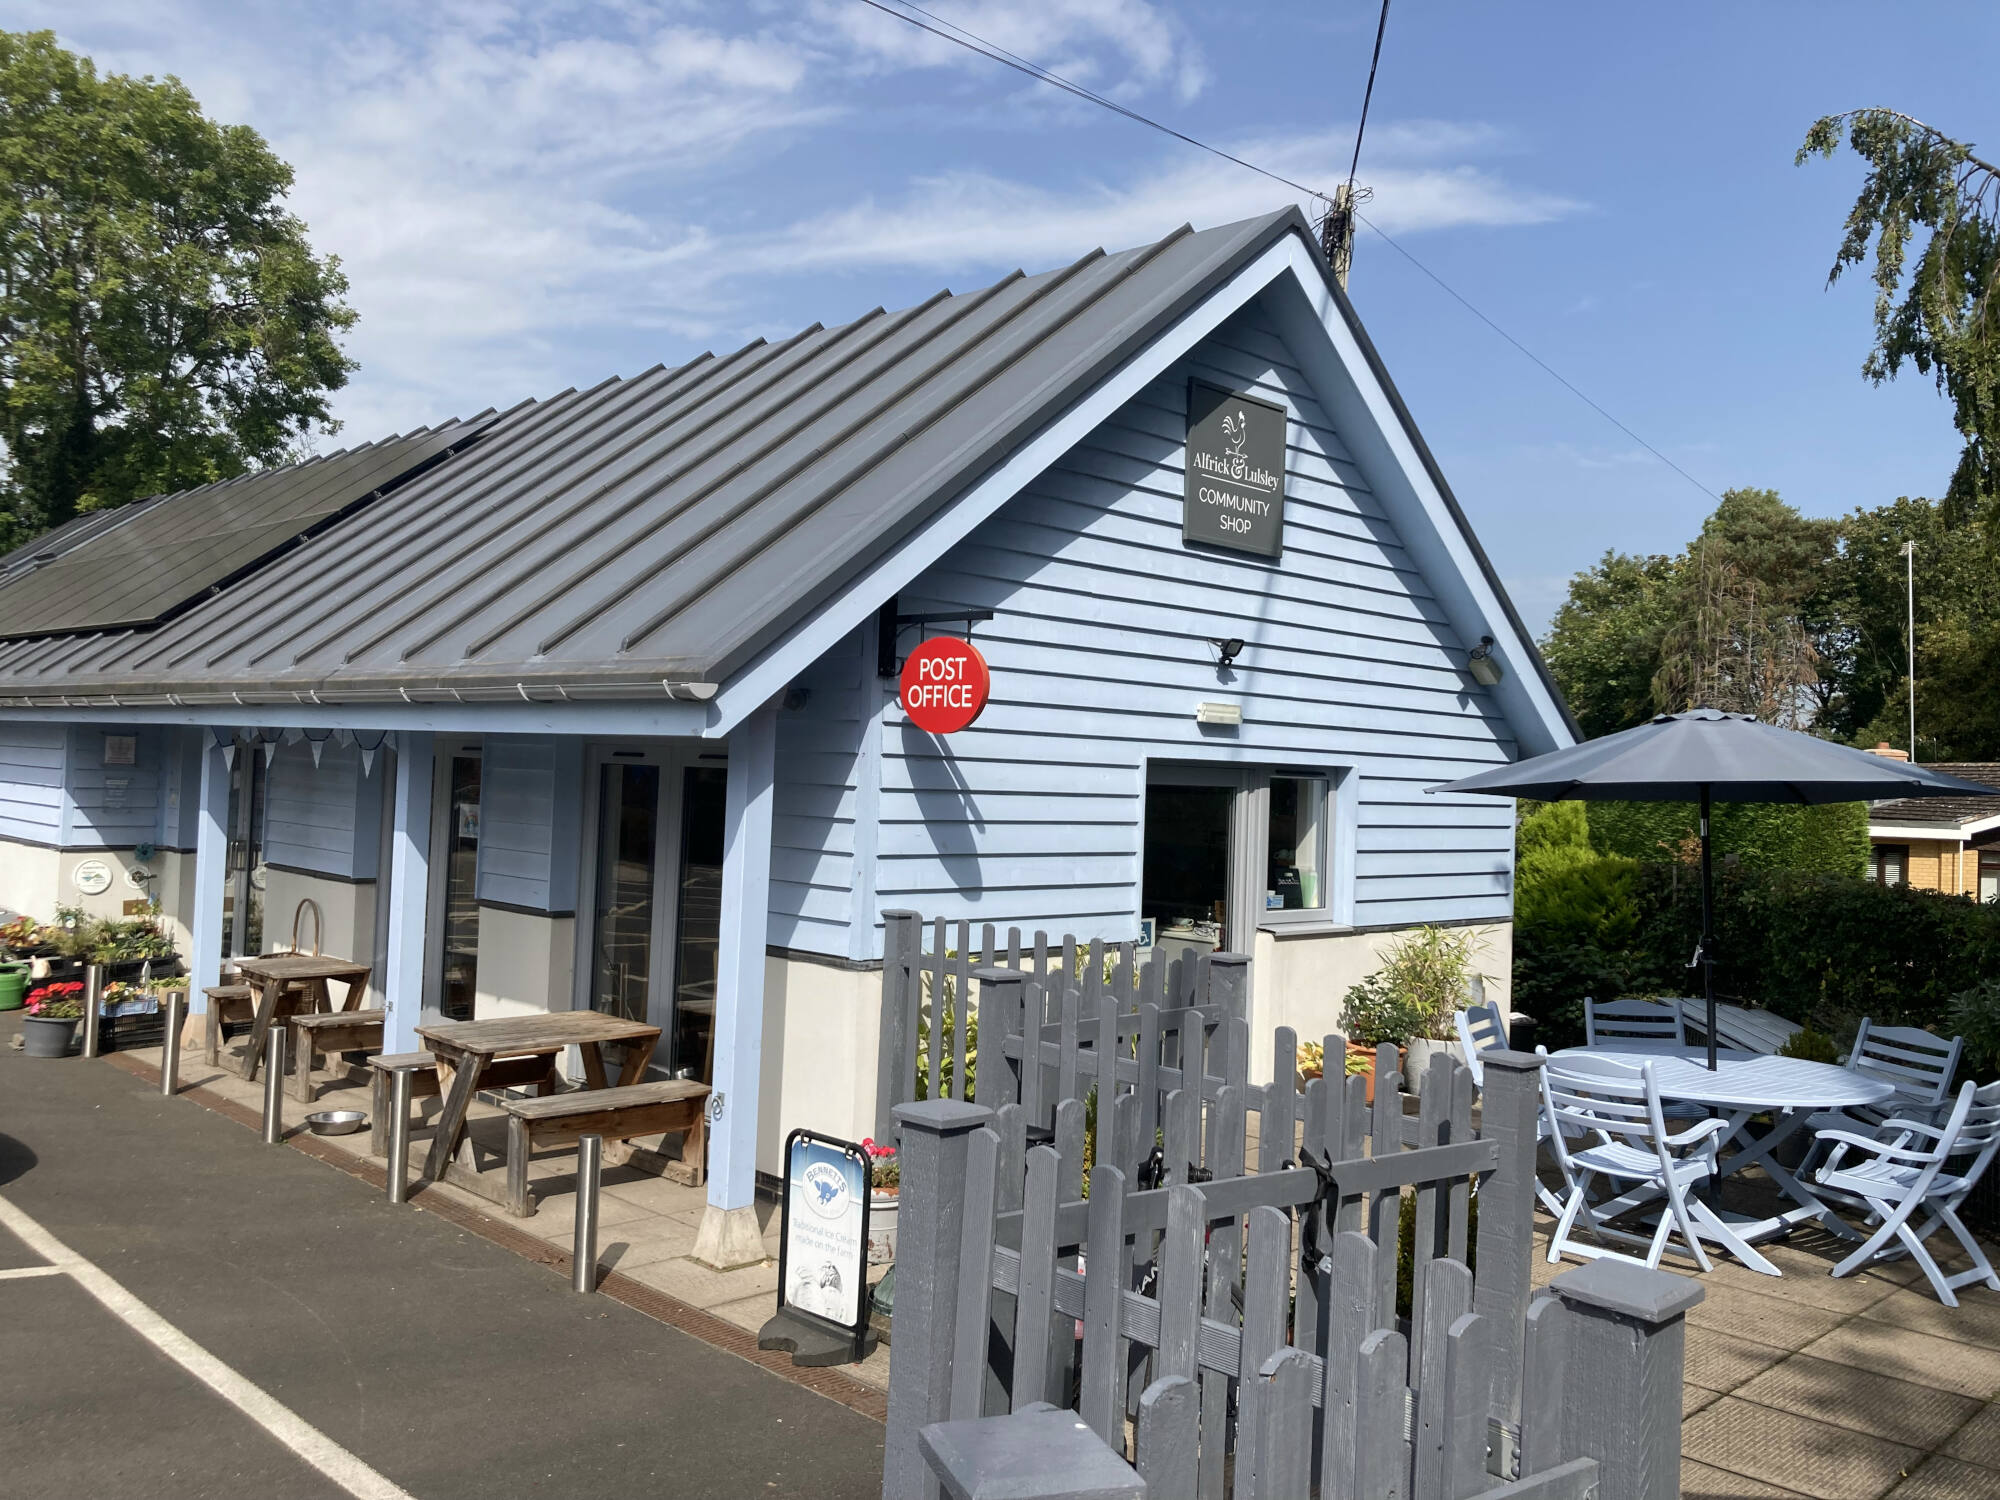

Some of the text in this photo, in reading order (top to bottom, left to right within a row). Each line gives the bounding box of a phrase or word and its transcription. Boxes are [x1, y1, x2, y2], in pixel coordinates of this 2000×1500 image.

[1193, 452, 1279, 490] Alfrick & Lulsley
[1199, 487, 1270, 517] COMMUNITY
[1220, 514, 1252, 534] SHOP
[920, 657, 967, 680] POST
[908, 684, 973, 708] OFFICE
[806, 1166, 847, 1193] BENNETTS
